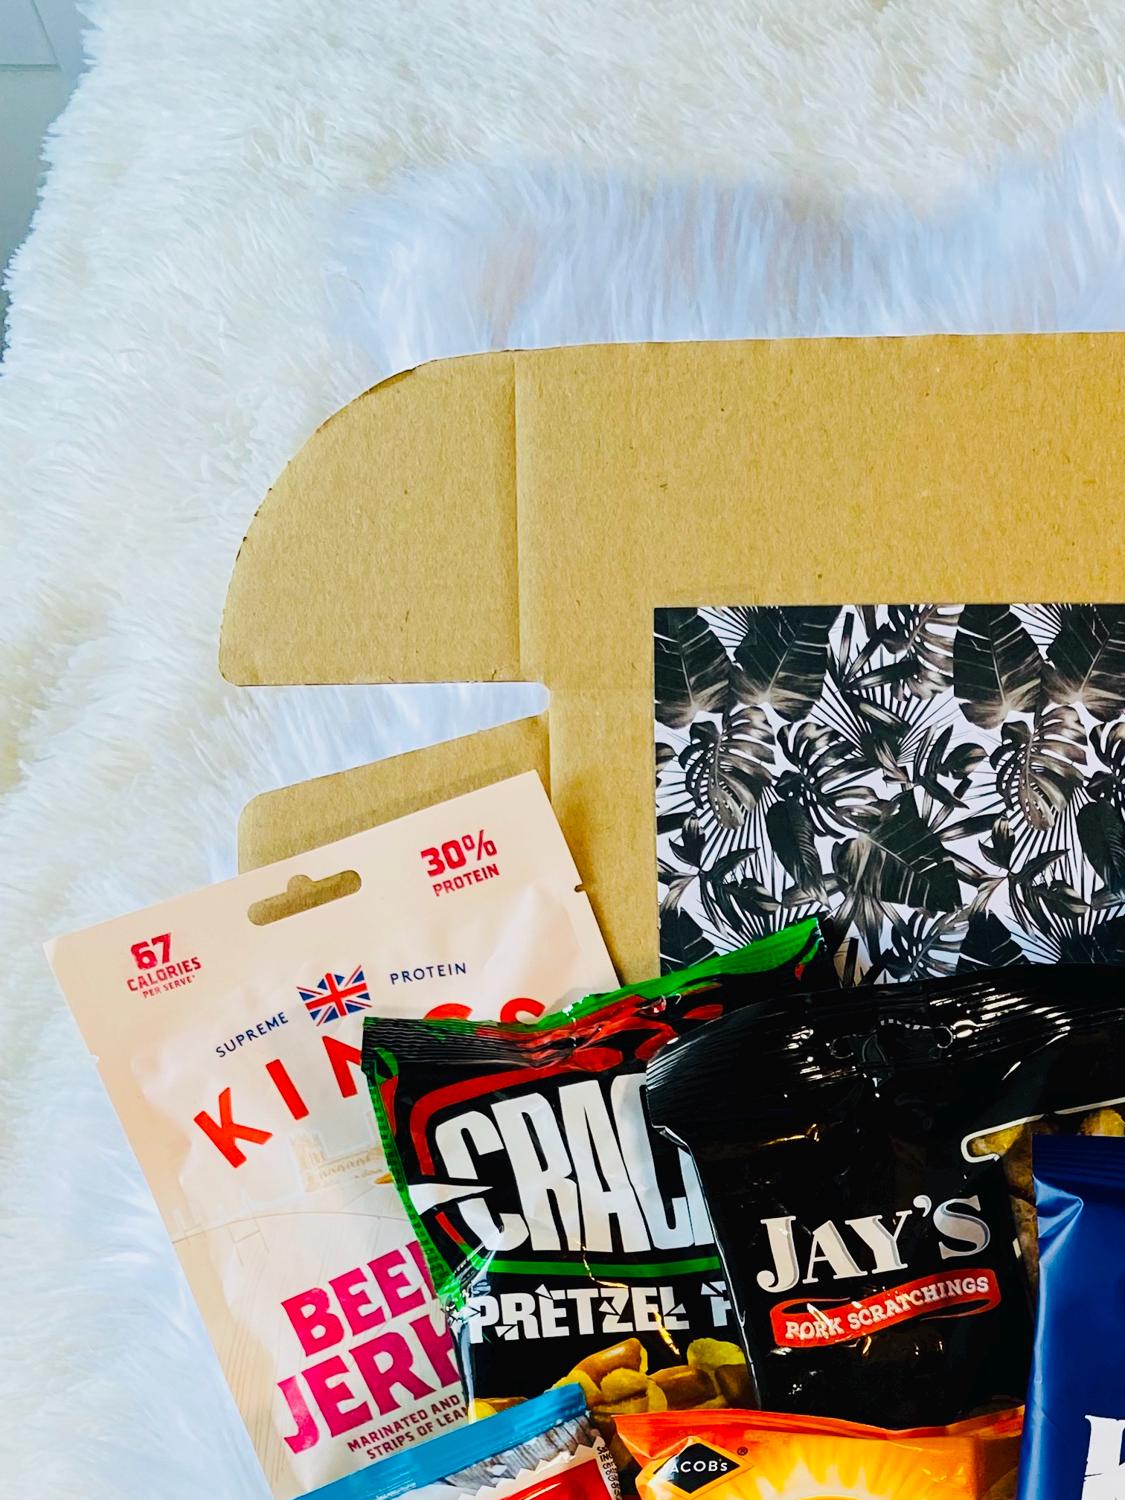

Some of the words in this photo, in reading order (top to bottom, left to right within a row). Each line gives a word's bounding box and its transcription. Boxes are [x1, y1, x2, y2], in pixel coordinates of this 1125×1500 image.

[420, 829, 498, 878] 30%
[432, 863, 500, 897] PROTEIN
[127, 957, 202, 991] CALORIES
[130, 932, 171, 970] 67
[142, 986, 161, 999] PER
[215, 1011, 289, 1058] SUPREME
[390, 961, 467, 985] PROTEIN
[194, 997, 546, 1168] KIN
[756, 1194, 992, 1294] JAY'S
[468, 1285, 691, 1345] PRETZEL
[784, 1316, 845, 1341] PORK
[847, 1276, 990, 1330] SCRATCHINGS
[347, 1409, 428, 1452] MARINATED
[431, 1394, 460, 1415] AND
[366, 1431, 415, 1460] STRIPS
[416, 1421, 434, 1437] OF
